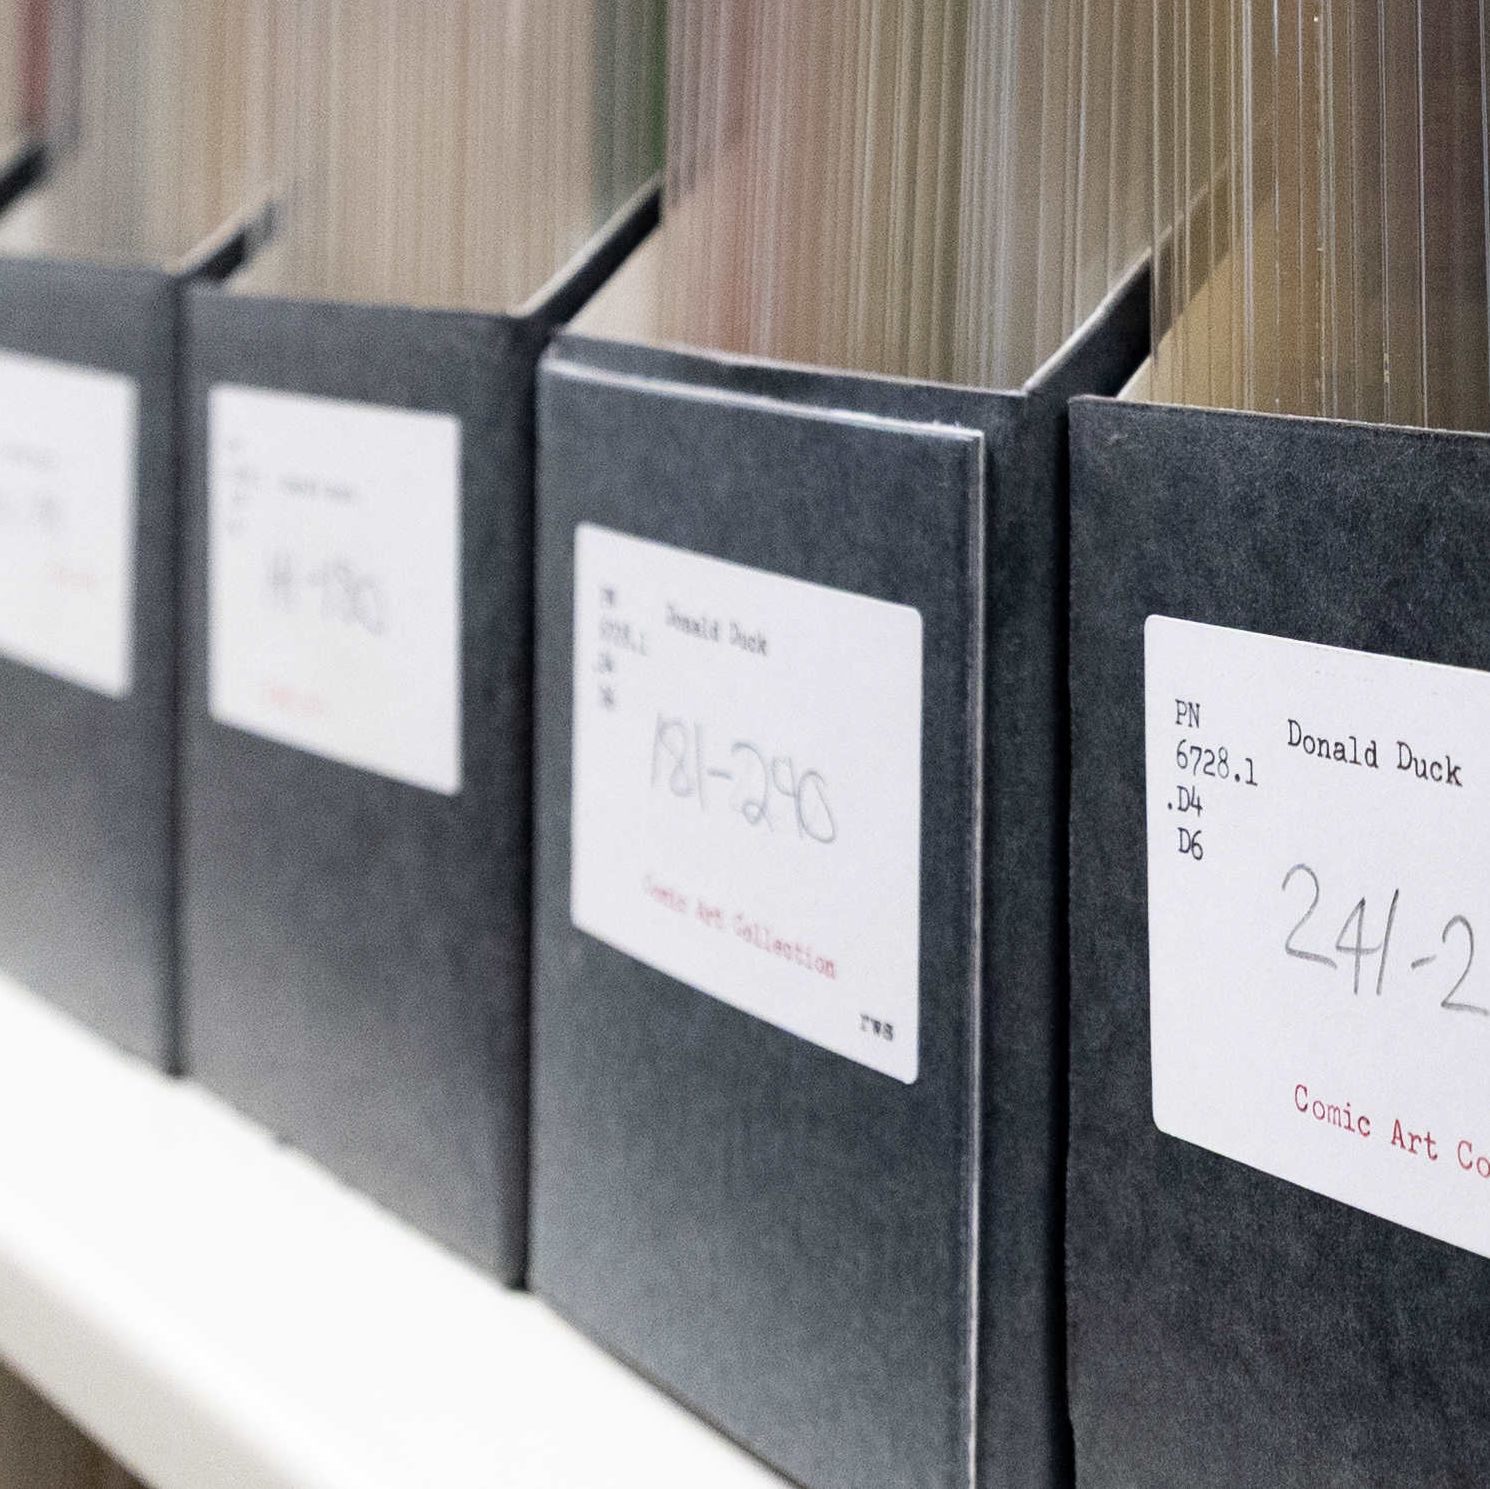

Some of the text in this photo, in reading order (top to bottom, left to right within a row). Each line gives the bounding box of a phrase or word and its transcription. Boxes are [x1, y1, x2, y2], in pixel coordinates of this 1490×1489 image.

[728, 620, 769, 656] Duck
[1175, 698, 1201, 729] PN
[1176, 740, 1258, 787] 6728.1
[1287, 718, 1464, 789] Donald Duck
[1167, 785, 1203, 816] .D4
[1177, 827, 1204, 860] D6
[733, 911, 837, 979] Collection
[858, 1013, 895, 1043] rws
[1294, 1084, 1372, 1139] Comic
[1390, 1117, 1439, 1163] Art
